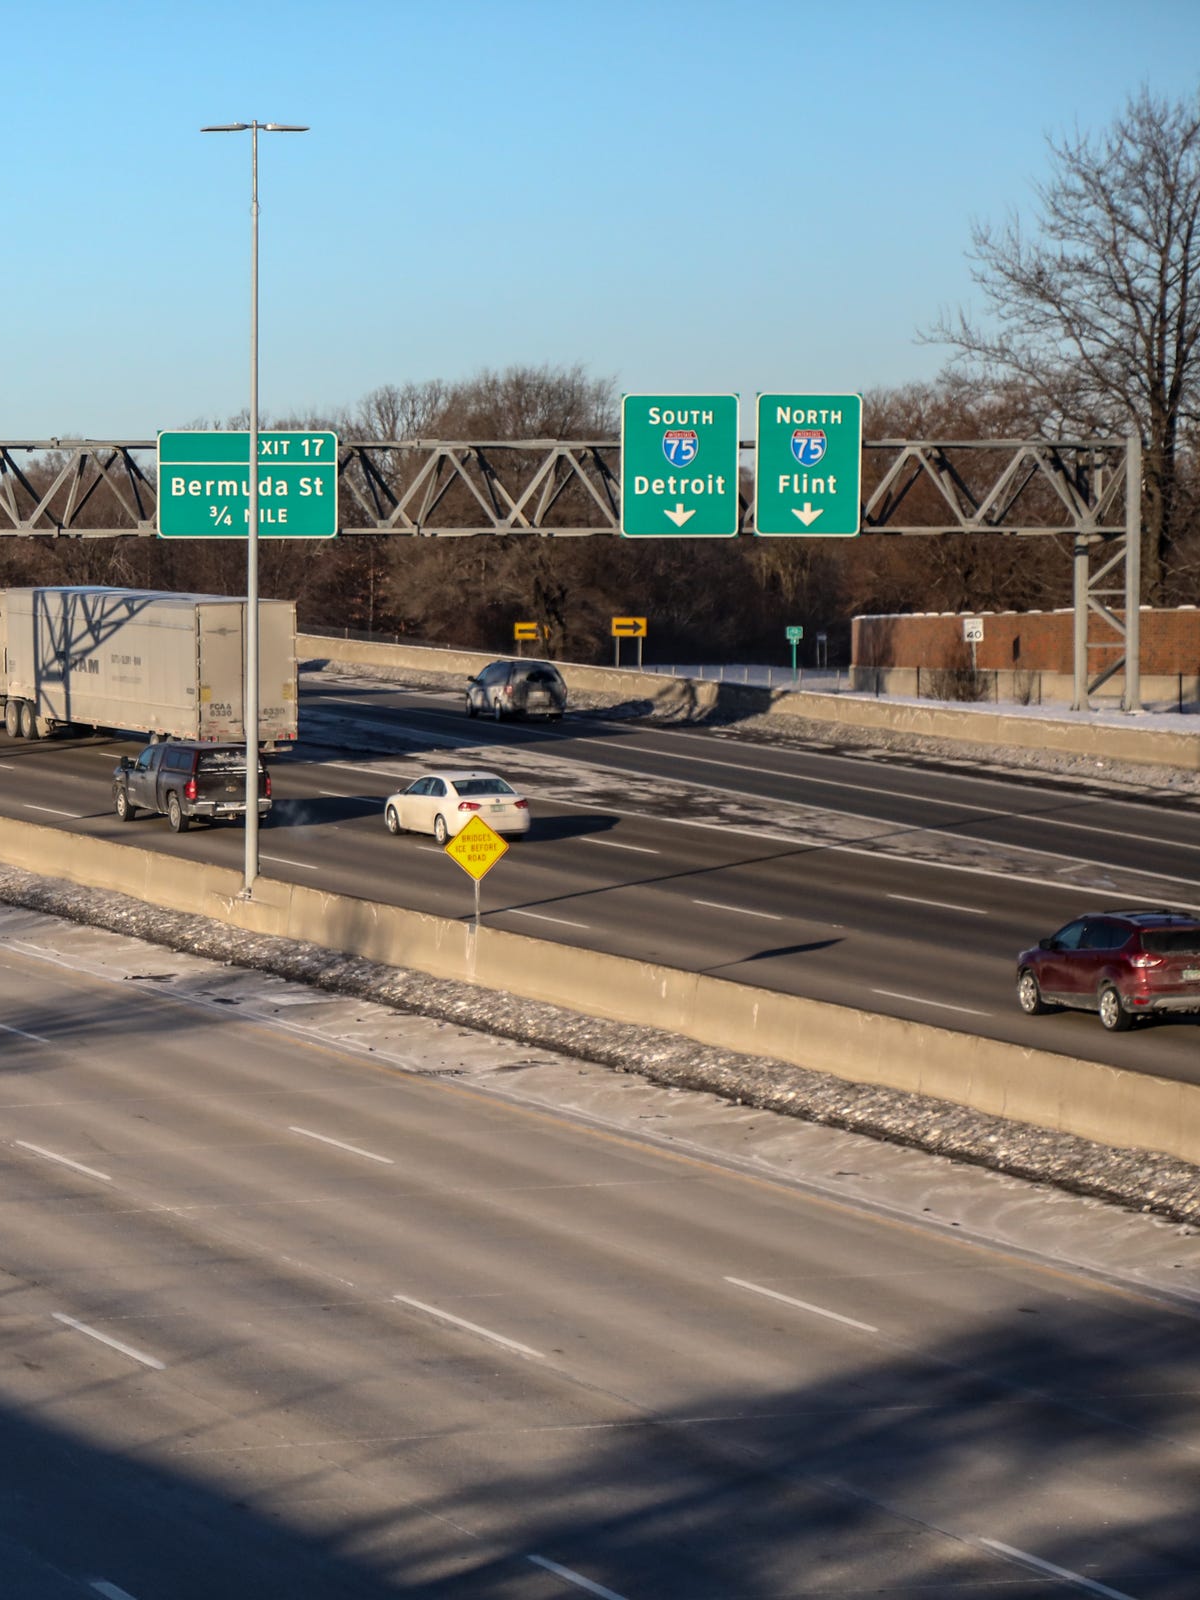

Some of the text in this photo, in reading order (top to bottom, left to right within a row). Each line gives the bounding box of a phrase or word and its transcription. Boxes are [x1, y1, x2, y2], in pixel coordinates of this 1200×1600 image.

[256, 439, 325, 456] XIT 17
[666, 439, 695, 460] 75
[794, 438, 823, 459] 75
[299, 477, 324, 496] St
[634, 474, 725, 495] Detroit
[778, 474, 837, 494] Flint
[966, 630, 982, 639] 40
[462, 834, 491, 843] BRIDGES
[456, 843, 497, 853] ICE BEFORE
[467, 854, 487, 862] ROAD
